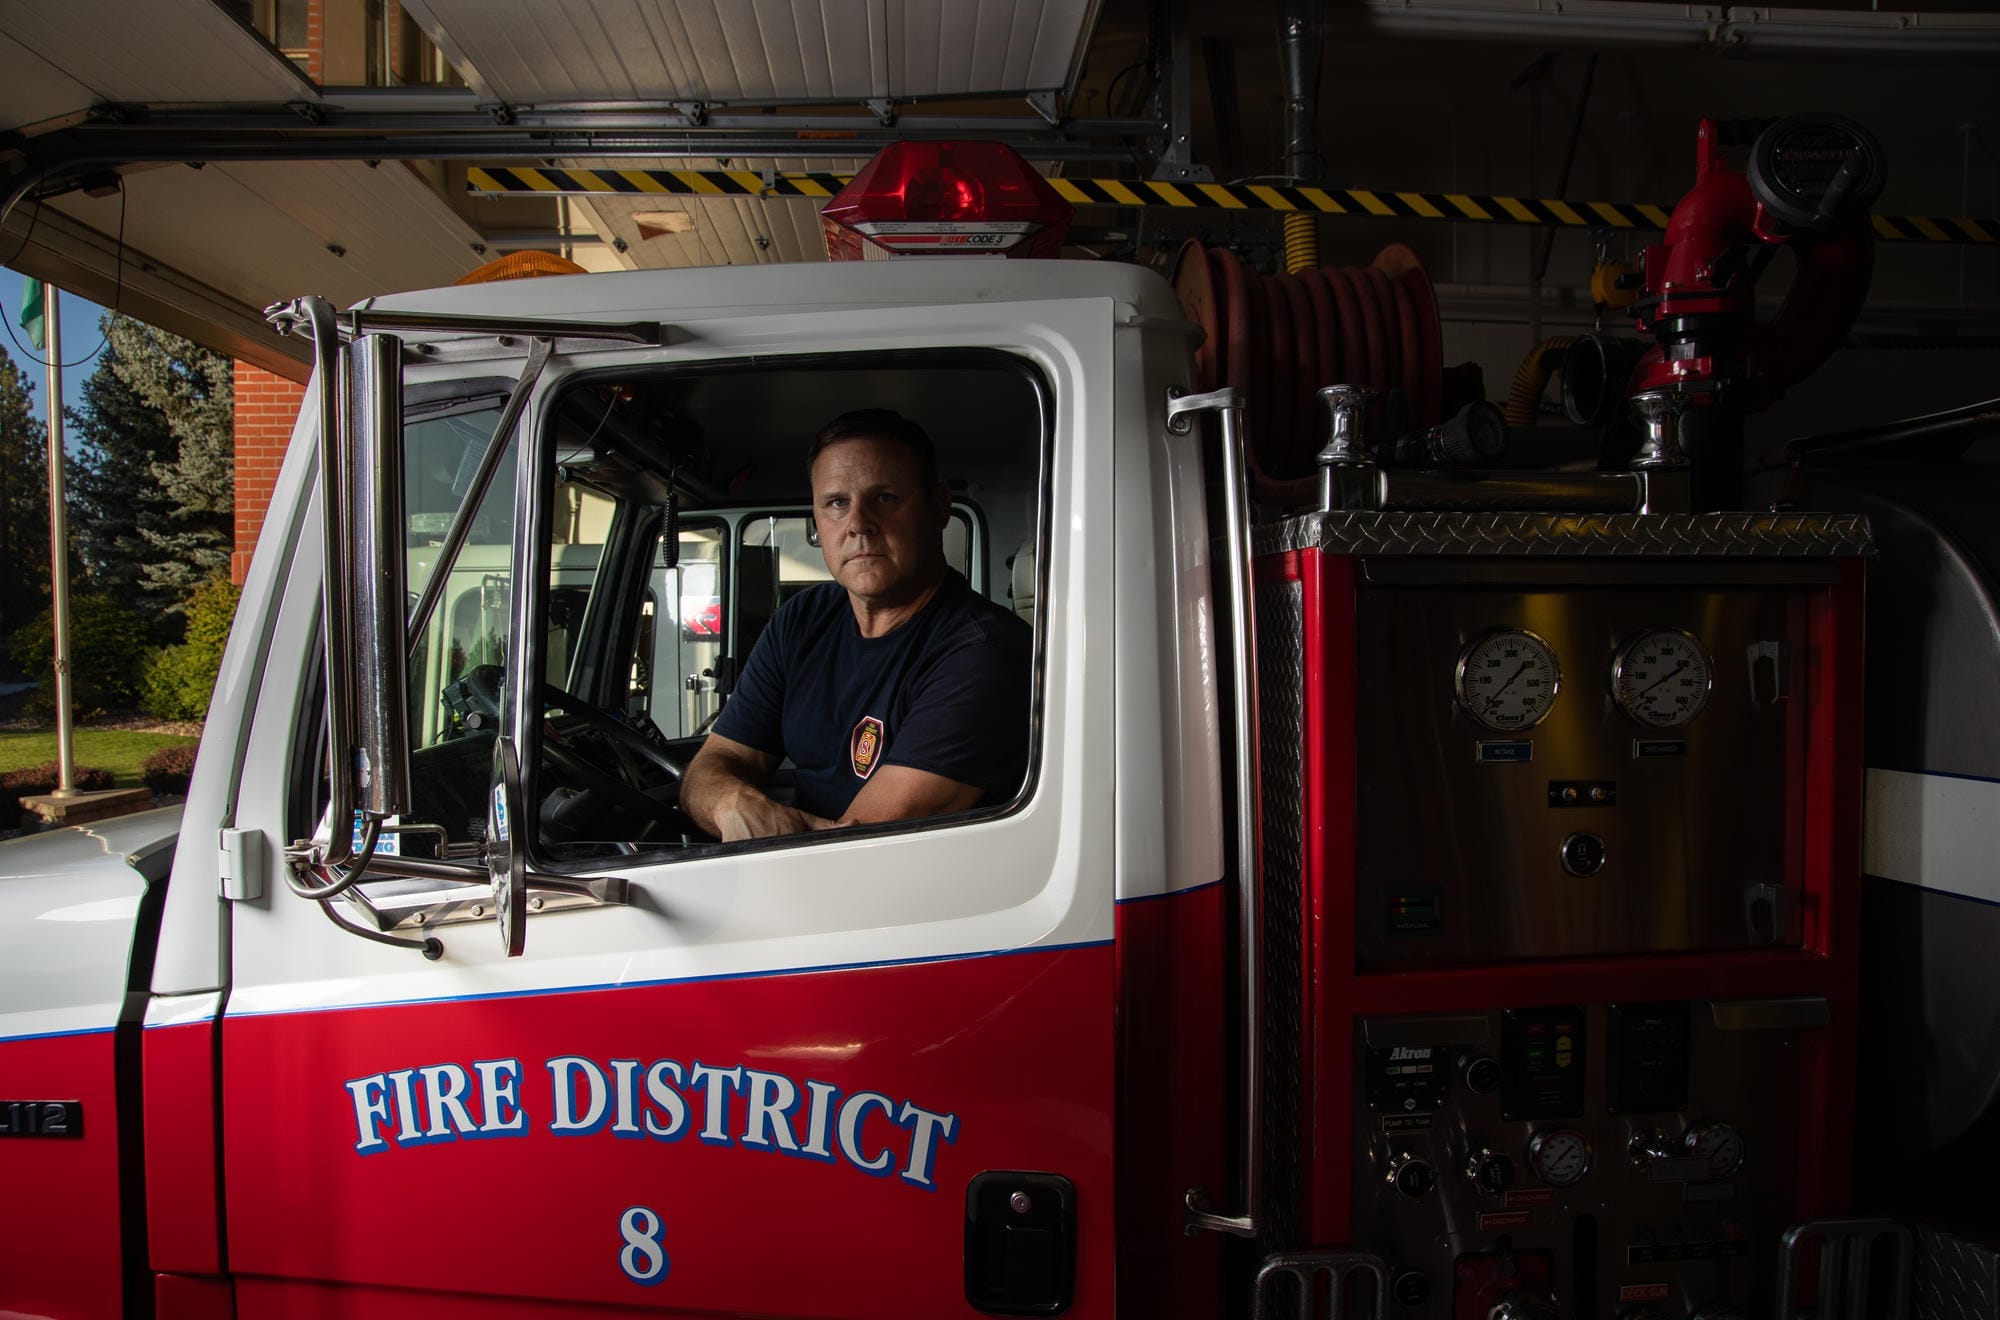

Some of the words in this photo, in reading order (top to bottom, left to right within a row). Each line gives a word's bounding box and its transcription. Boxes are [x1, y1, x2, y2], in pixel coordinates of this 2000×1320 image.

[966, 234, 995, 244] CODE
[996, 234, 1004, 244] 3
[1504, 649, 1518, 658] 300
[1660, 647, 1674, 656] 300
[1487, 660, 1501, 668] 200
[1643, 656, 1657, 664] 200
[1634, 671, 1647, 680] 100
[1479, 676, 1492, 685] 100
[1526, 679, 1540, 688] 500
[1680, 678, 1694, 687] 500
[1522, 697, 1536, 706] 600
[1675, 696, 1689, 705] 600
[1389, 1047, 1432, 1060] Akron
[0, 1103, 68, 1135] 112
[346, 1058, 527, 1154] FIRE
[546, 1056, 957, 1189] DISTRICT
[619, 1205, 667, 1284] 8
[1623, 1287, 1647, 1298] DECK
[1648, 1286, 1668, 1297] GUN
